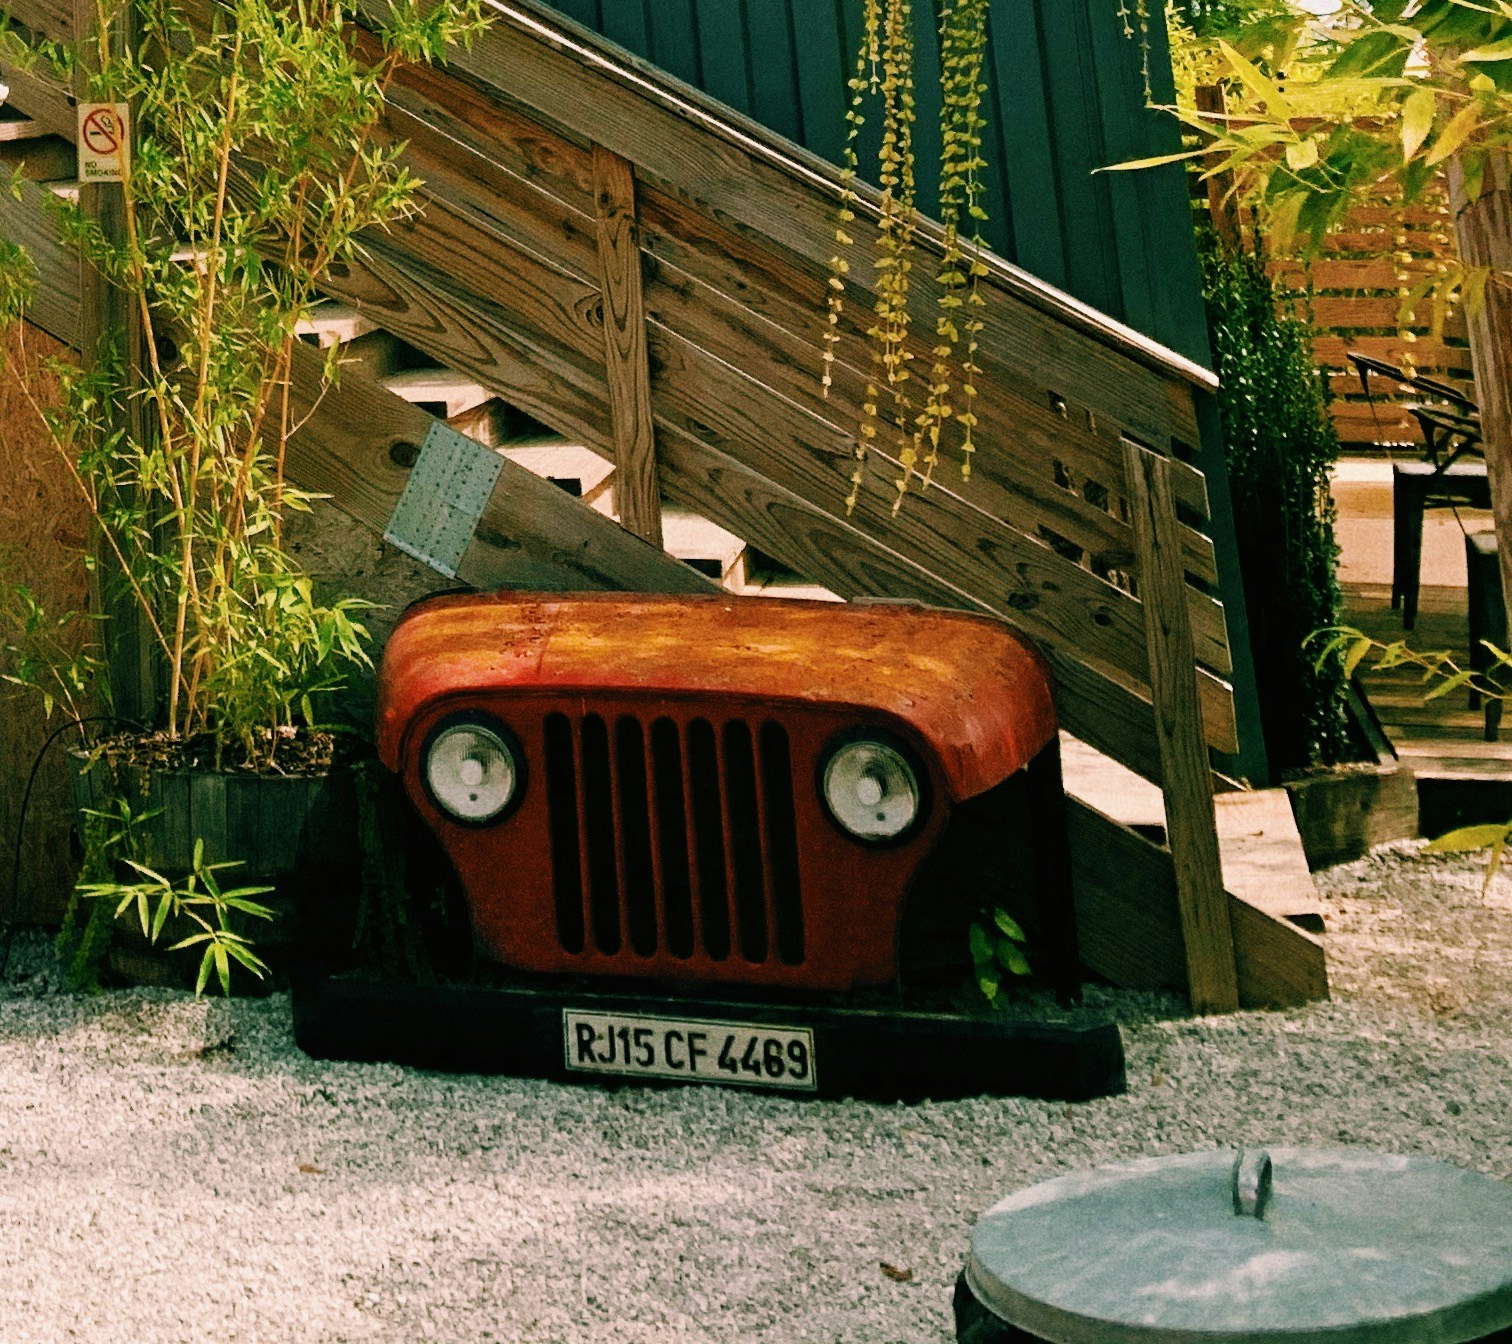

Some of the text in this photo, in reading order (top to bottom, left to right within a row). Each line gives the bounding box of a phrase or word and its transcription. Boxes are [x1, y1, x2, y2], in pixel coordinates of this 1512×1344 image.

[575, 1022, 810, 1080] RJ15 CF 4469
